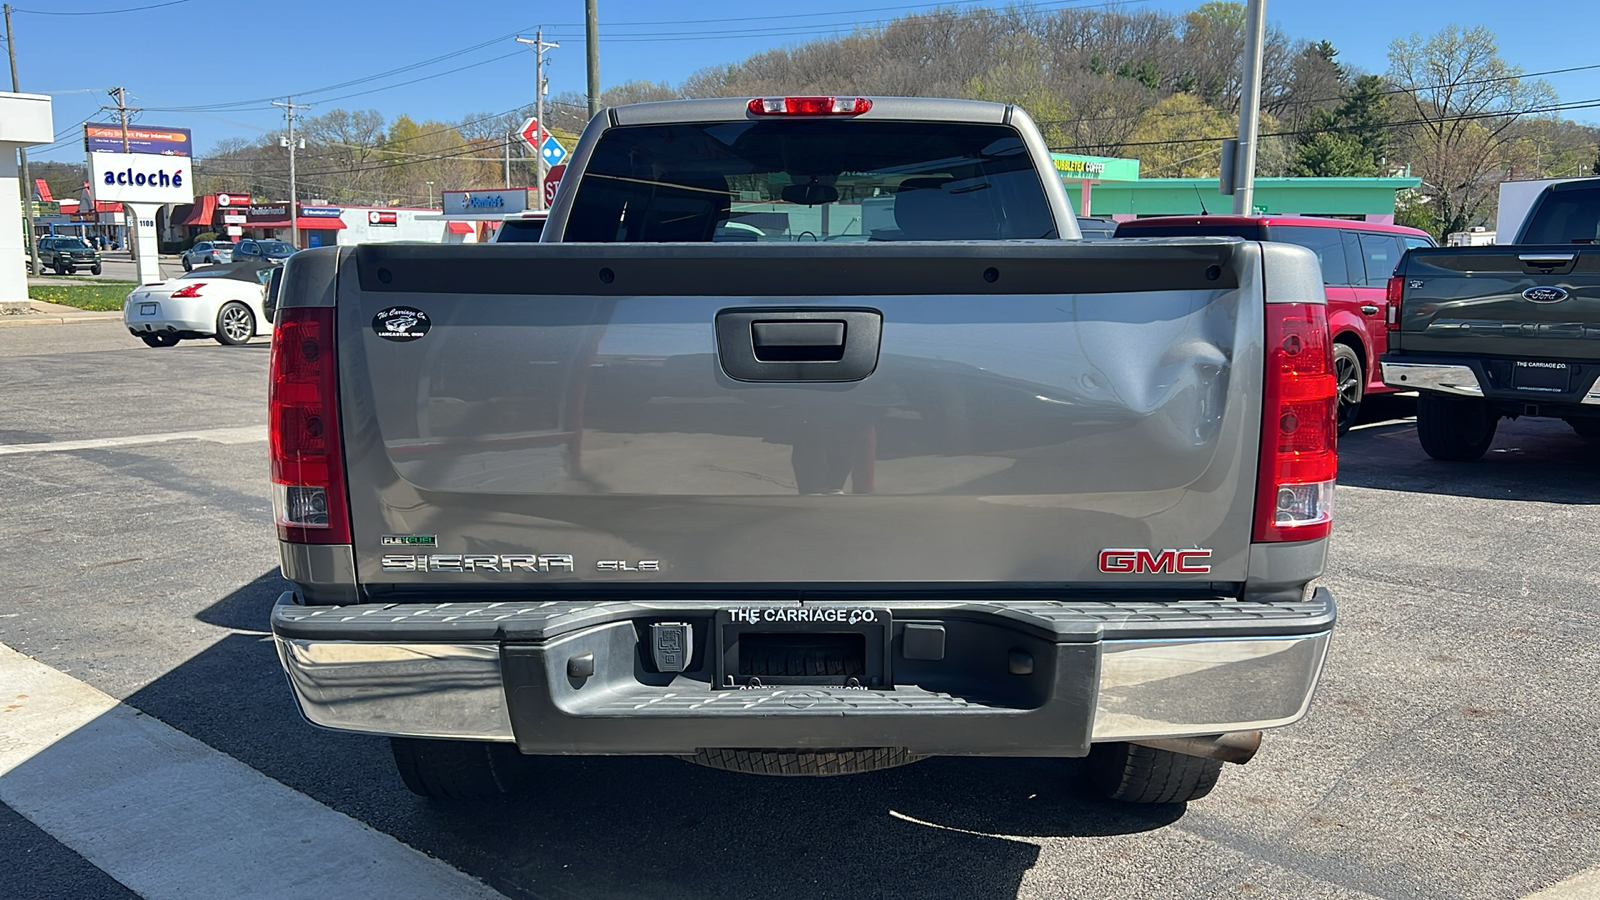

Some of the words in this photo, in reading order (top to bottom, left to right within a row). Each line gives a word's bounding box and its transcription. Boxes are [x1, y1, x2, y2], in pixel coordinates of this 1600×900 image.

[1086, 161, 1105, 173] COFFEE
[104, 168, 182, 188] acloché
[546, 181, 560, 200] ST
[470, 195, 504, 208] Domino's
[377, 311, 388, 320] The
[389, 308, 416, 317] Carriage
[381, 554, 574, 573] SIERRA
[596, 560, 660, 572] SLE
[1099, 548, 1213, 574] GMC
[728, 609, 760, 623] THE
[764, 609, 847, 622] CARRIAGE
[849, 609, 878, 623] CO.
